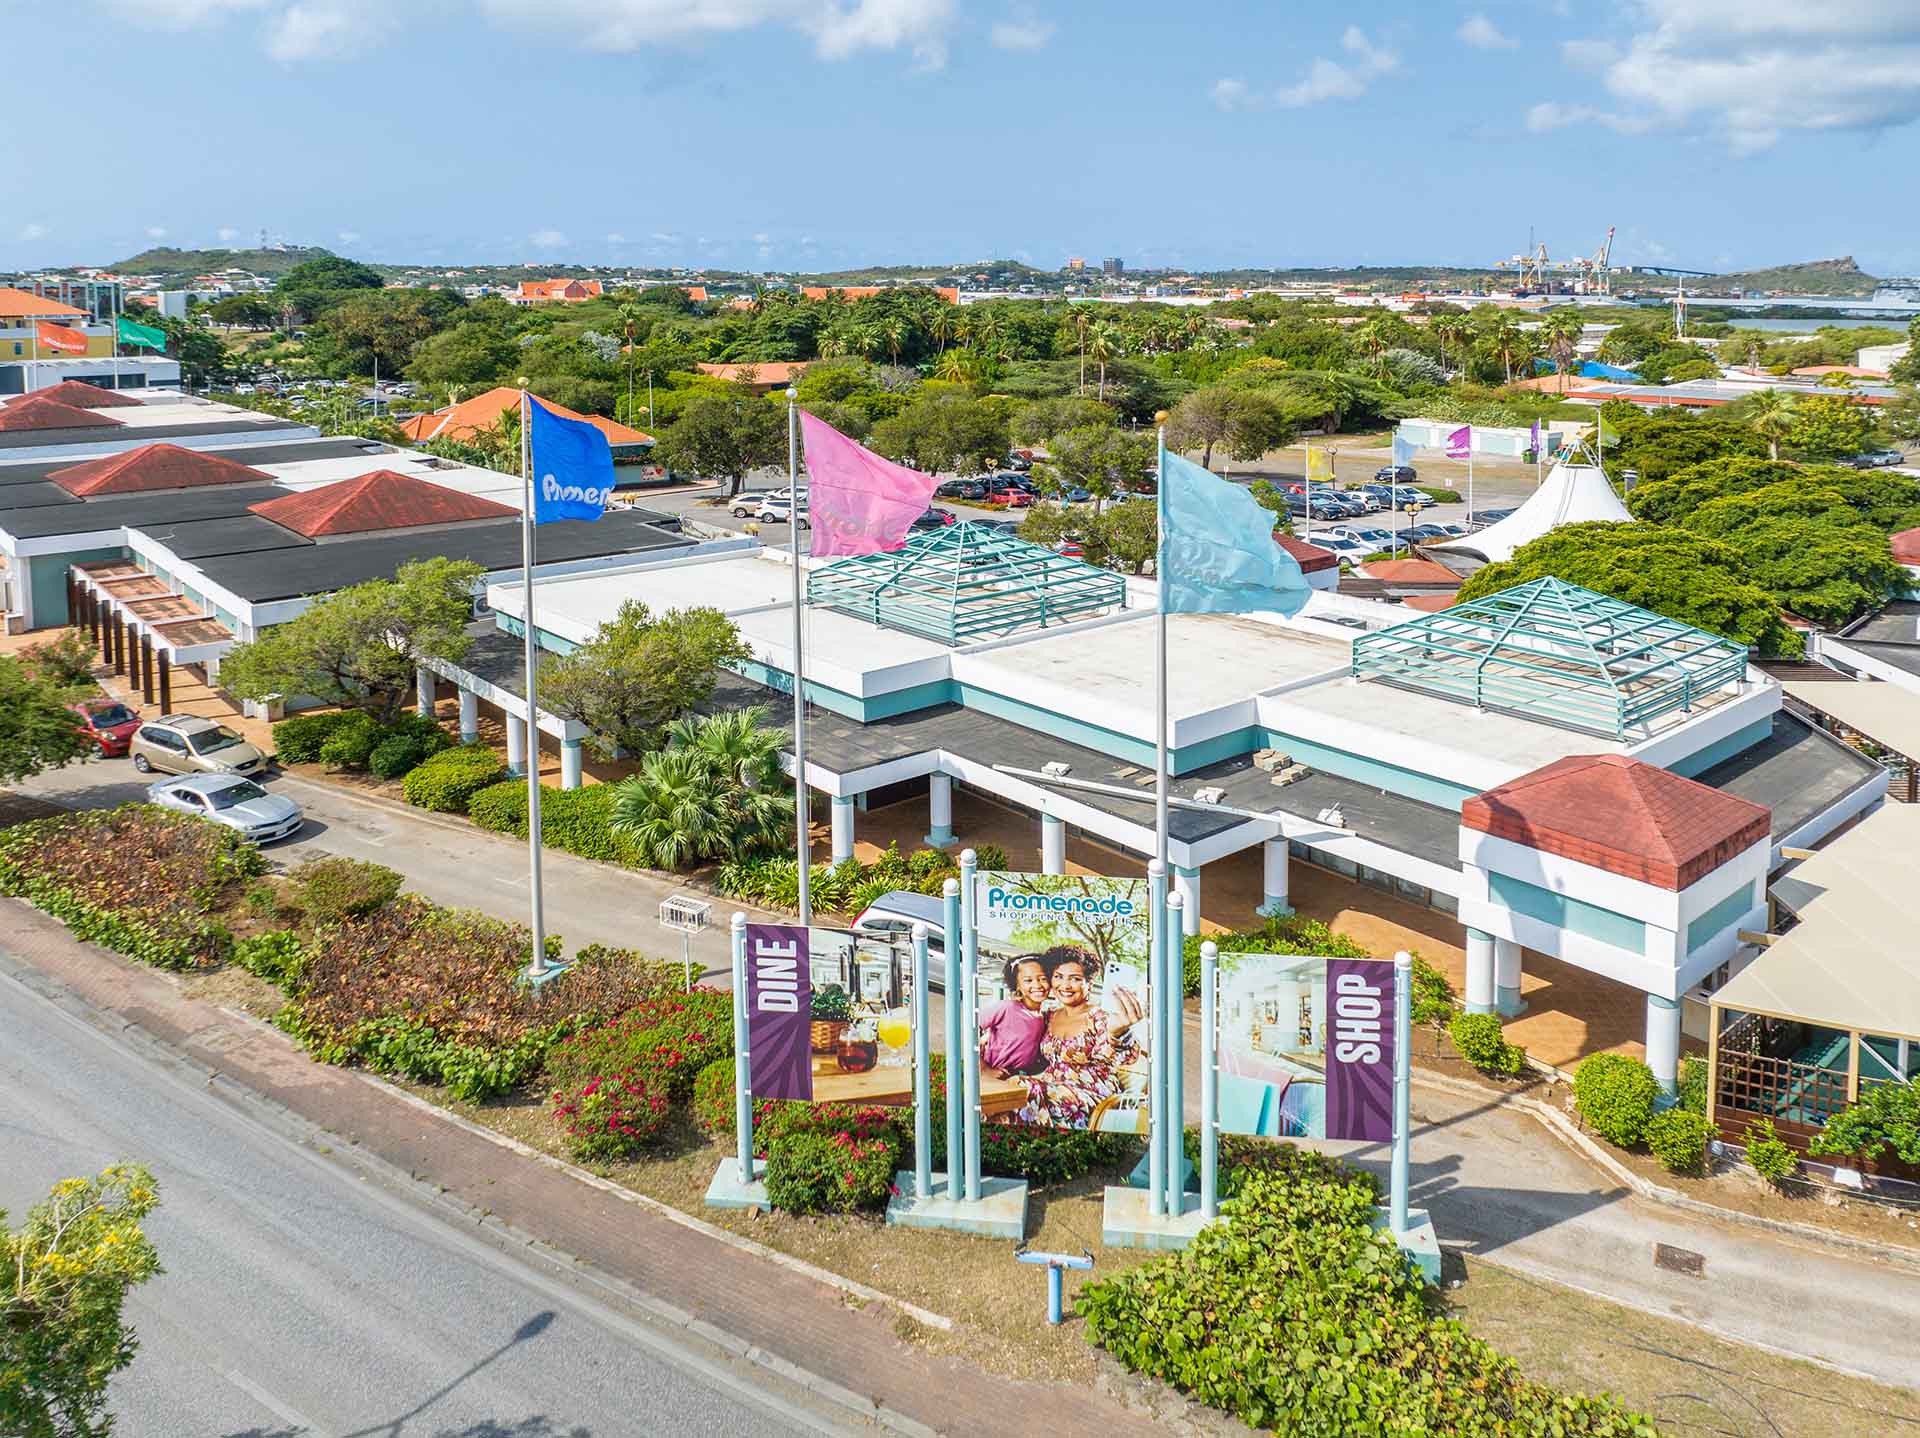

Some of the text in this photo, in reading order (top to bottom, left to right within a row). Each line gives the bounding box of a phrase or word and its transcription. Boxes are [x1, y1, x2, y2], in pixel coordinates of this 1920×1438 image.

[988, 887, 1133, 915] Promenade
[989, 911, 1134, 926] SHOPPING CENTER
[756, 938, 798, 1013] DINE
[1336, 974, 1381, 1064] SHOP
